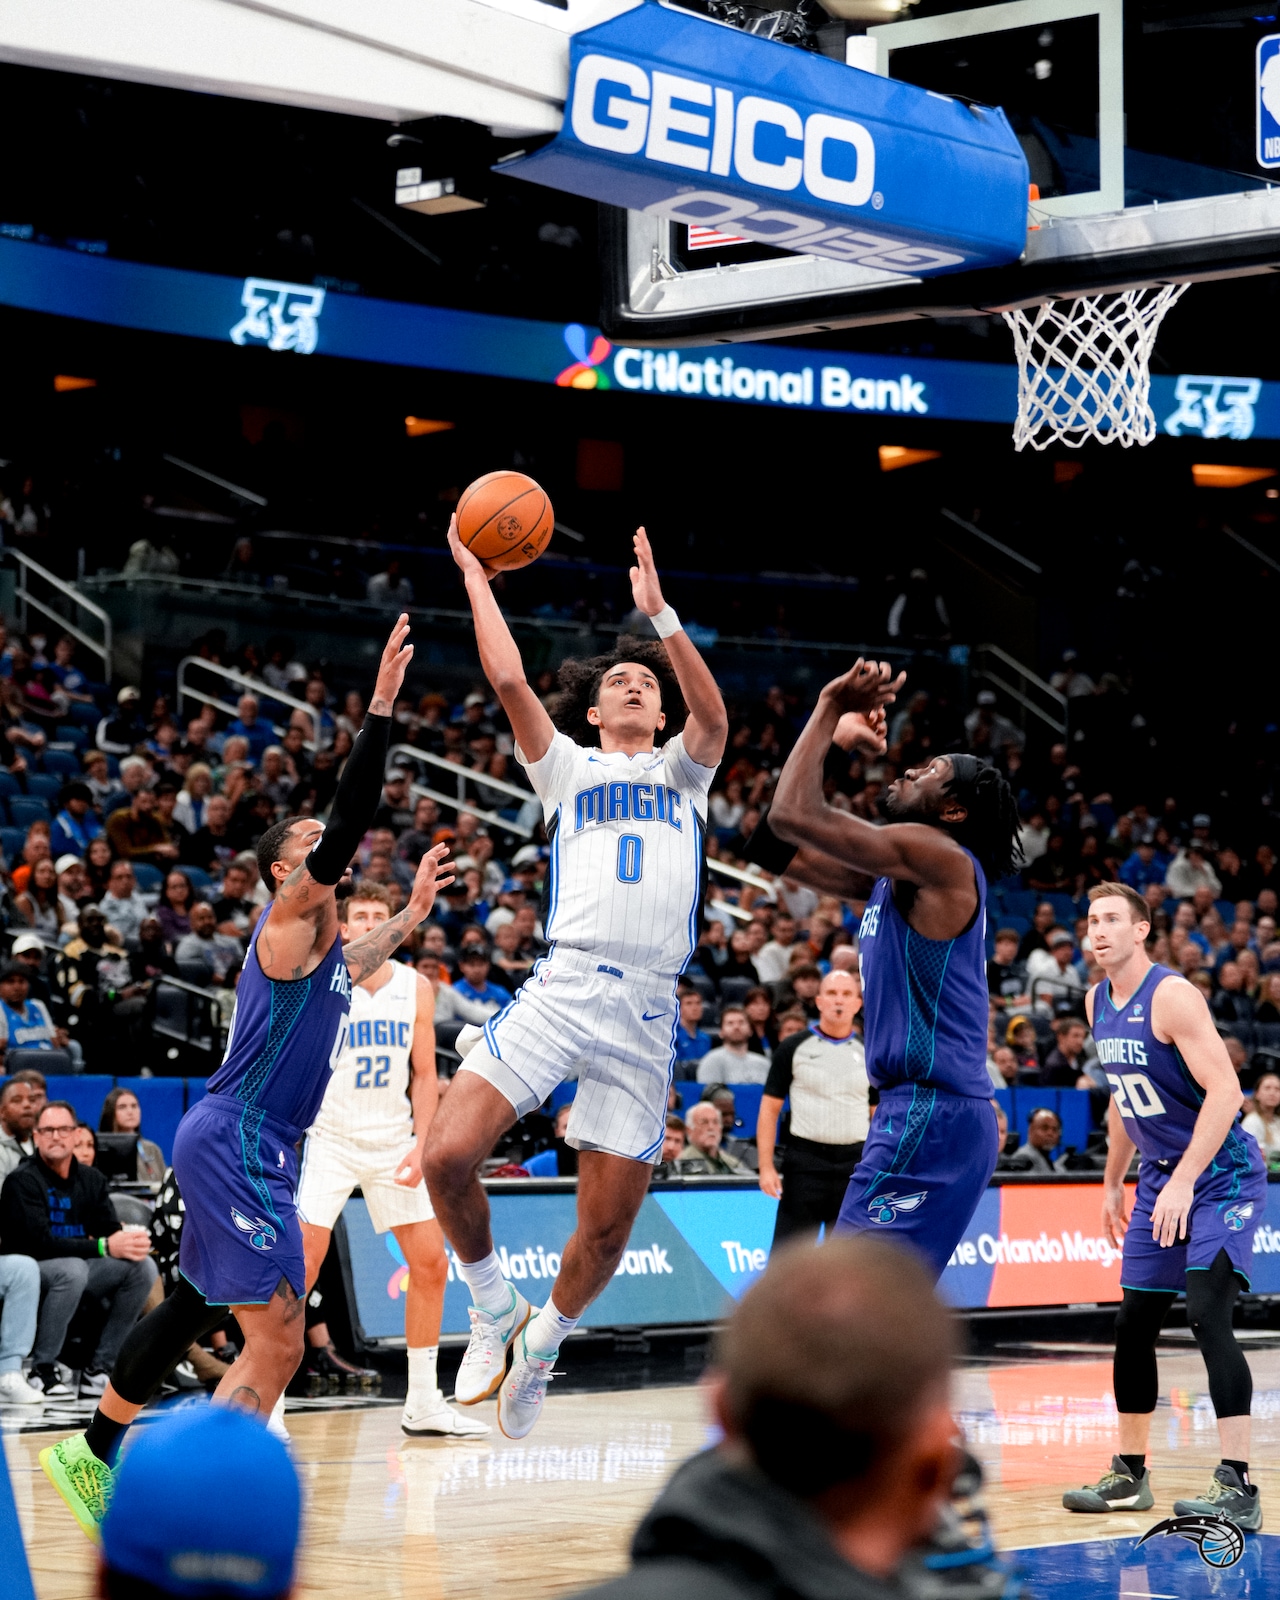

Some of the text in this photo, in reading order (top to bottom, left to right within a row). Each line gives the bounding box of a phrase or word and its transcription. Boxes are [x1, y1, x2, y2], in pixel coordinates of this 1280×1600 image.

[572, 53, 876, 207] GEICO
[1264, 136, 1280, 159] NB
[643, 190, 965, 272] GEICO
[820, 367, 928, 413] Bank
[574, 781, 683, 833] MAGIC
[616, 833, 644, 884] 0
[354, 1055, 391, 1090] 22
[1105, 1073, 1167, 1118] 20
[720, 1240, 767, 1274] The
[977, 1232, 1063, 1265] Orlando
